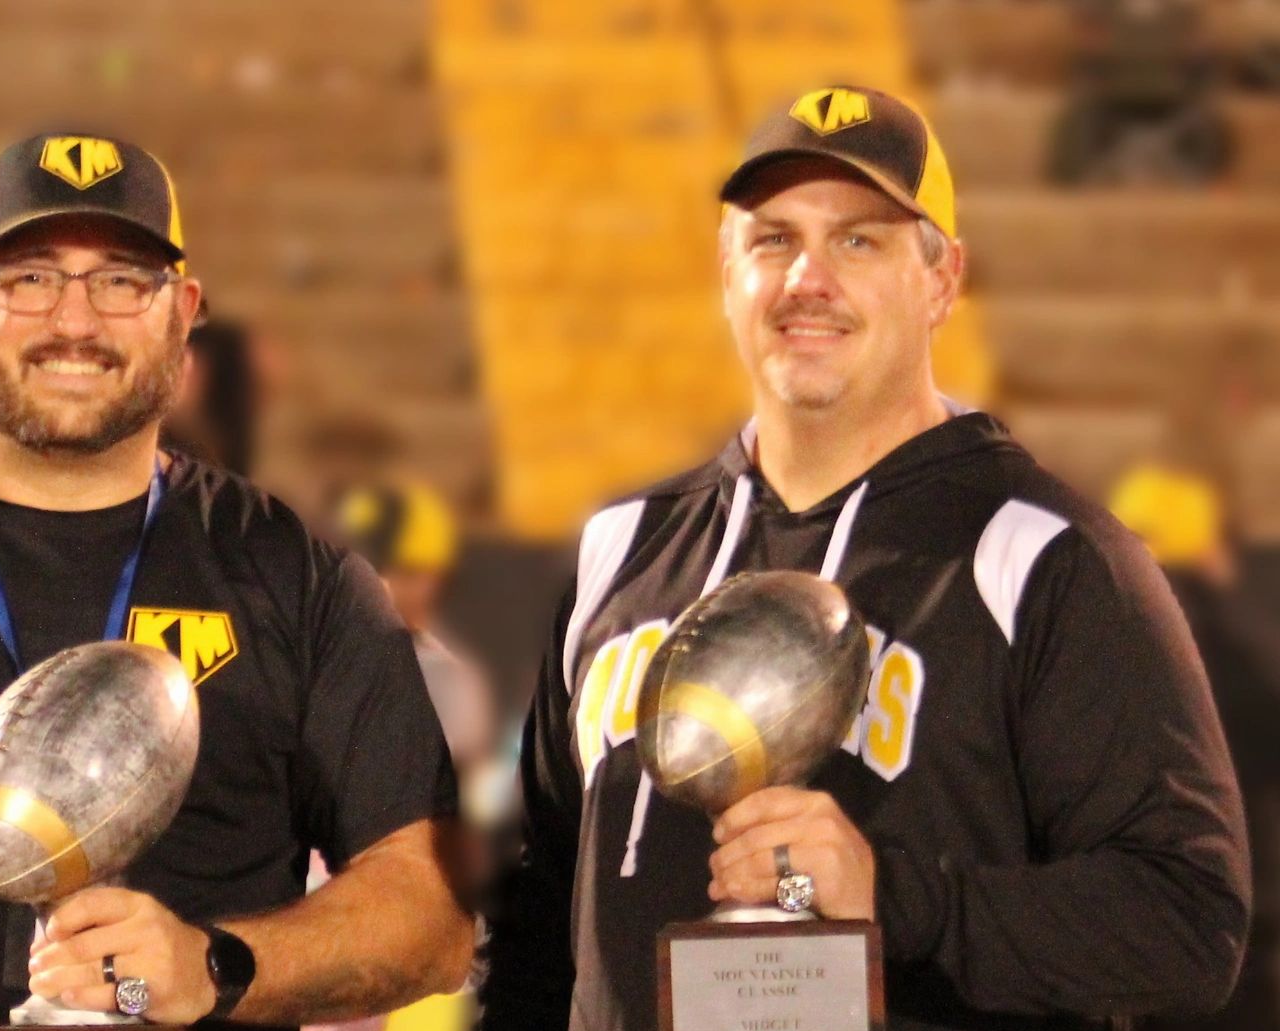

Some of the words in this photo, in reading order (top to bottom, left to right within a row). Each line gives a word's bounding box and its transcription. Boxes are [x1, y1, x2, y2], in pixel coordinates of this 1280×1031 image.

[40, 136, 123, 190] KM
[130, 610, 232, 684] KM
[754, 952, 783, 963] THE
[713, 967, 826, 981] MOUNTAINEER
[737, 985, 798, 997] CLASSIC
